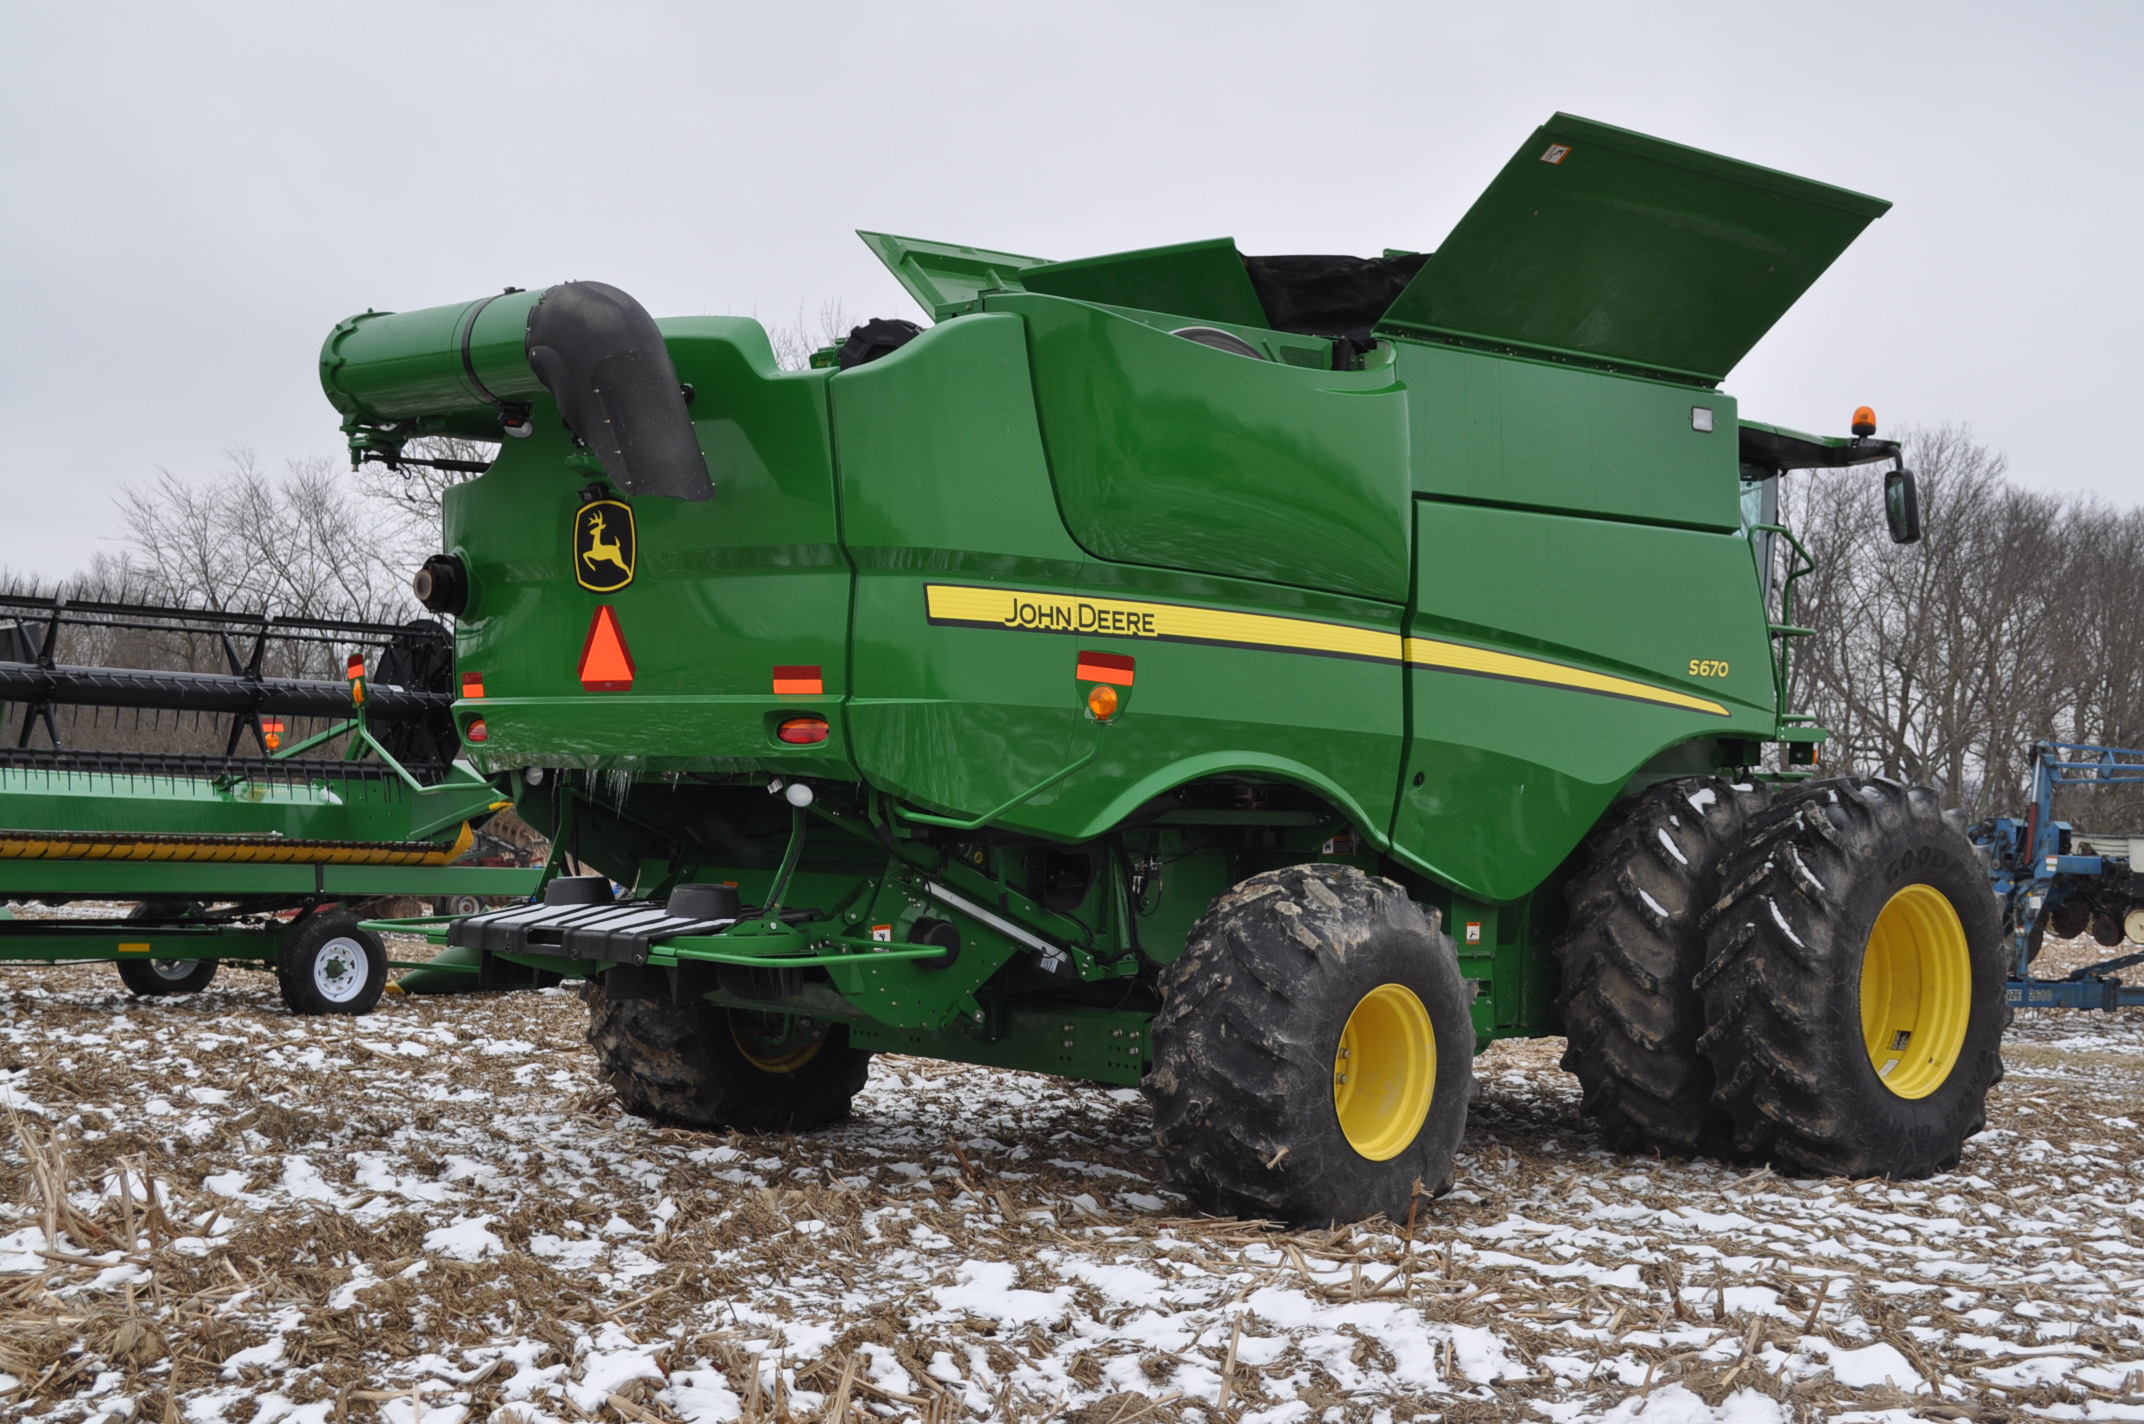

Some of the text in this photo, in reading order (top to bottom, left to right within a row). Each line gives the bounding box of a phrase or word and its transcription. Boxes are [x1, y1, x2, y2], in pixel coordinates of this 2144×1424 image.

[1004, 597, 1156, 634] JOHN DEERE
[1688, 658, 1729, 678] S670
